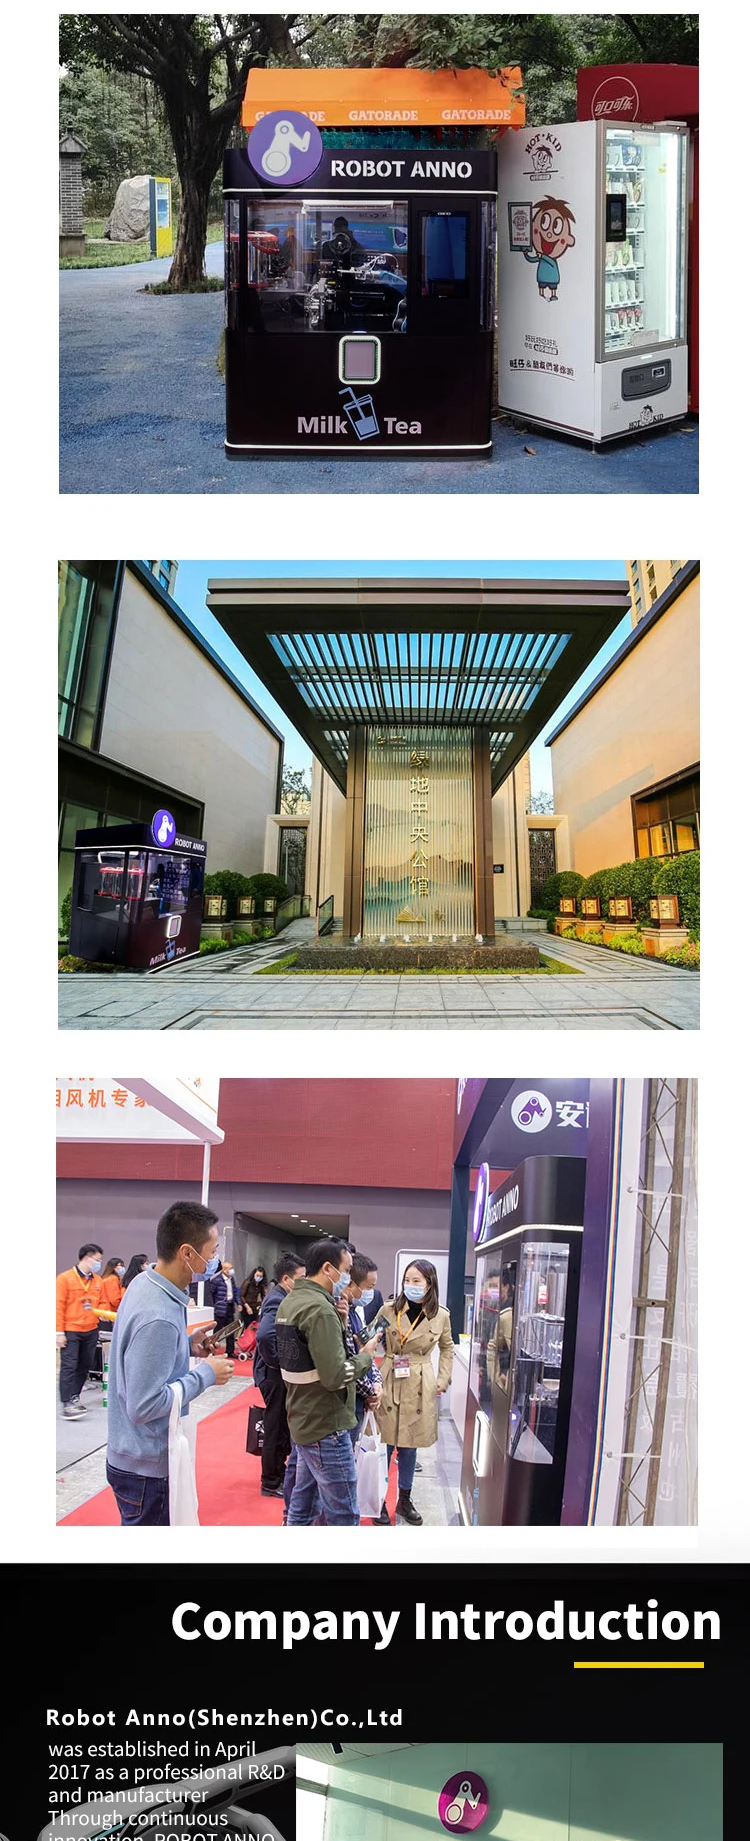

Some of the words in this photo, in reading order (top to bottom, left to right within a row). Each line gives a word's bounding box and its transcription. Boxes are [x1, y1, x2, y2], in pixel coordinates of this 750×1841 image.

[595, 96, 635, 115] 可口可乐
[348, 111, 418, 121] GATORADE
[442, 110, 512, 121] GATORADE
[331, 160, 405, 177] ROBOT
[410, 161, 473, 179] ANNO
[297, 415, 349, 436] Milk
[384, 416, 422, 436] Tea
[410, 750, 430, 897] 绿地中央公馆
[175, 838, 192, 849] ROBOT
[192, 842, 204, 852] ANNO
[150, 952, 167, 965] Milk
[176, 946, 186, 955] Tea
[555, 1100, 590, 1128] 安
